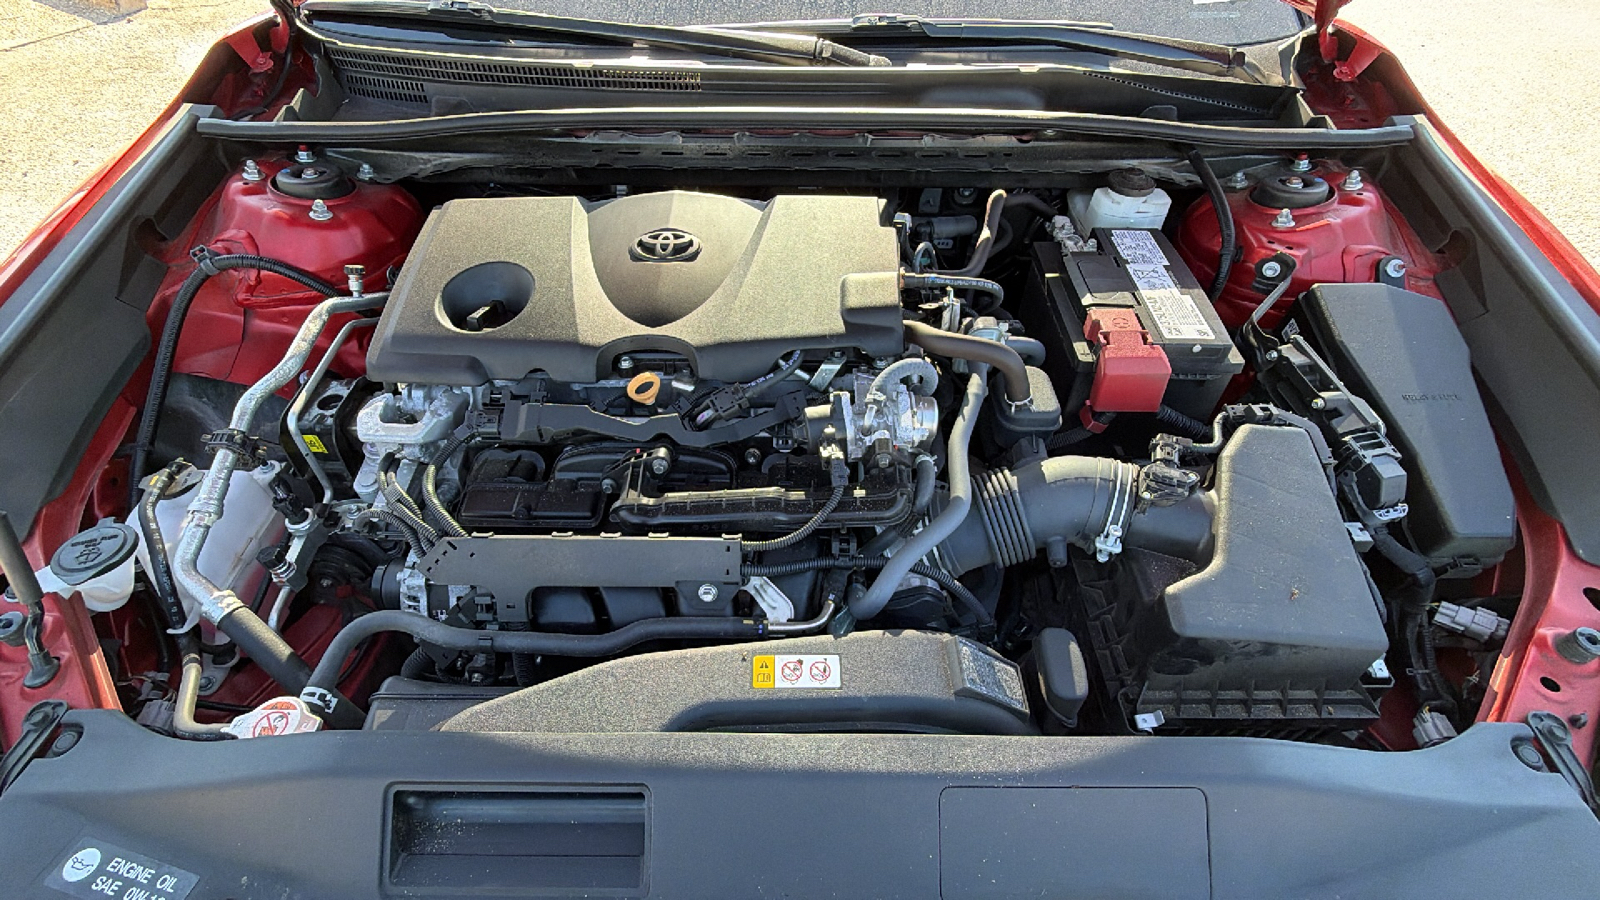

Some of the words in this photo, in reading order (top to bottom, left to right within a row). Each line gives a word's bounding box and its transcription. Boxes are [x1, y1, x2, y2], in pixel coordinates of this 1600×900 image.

[91, 876, 123, 896] SAE
[106, 857, 156, 884] ENGINE
[156, 874, 178, 893] OIL
